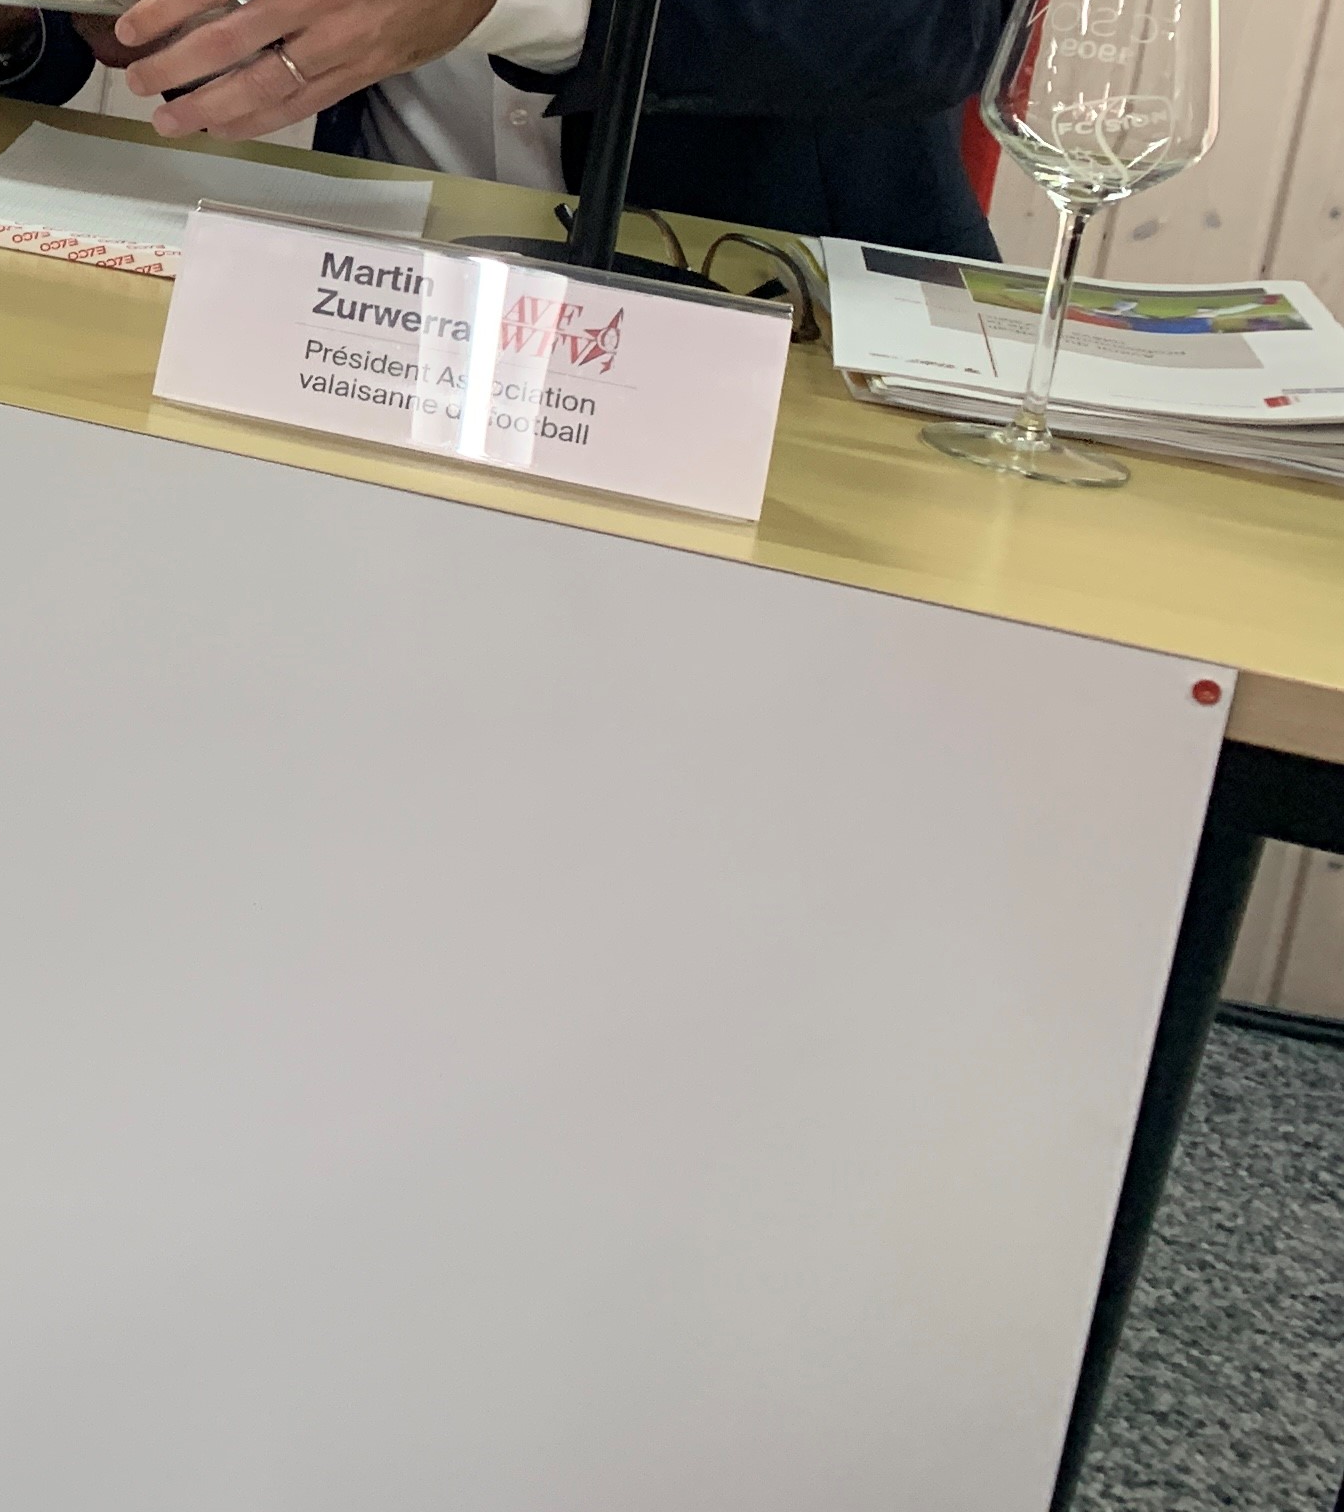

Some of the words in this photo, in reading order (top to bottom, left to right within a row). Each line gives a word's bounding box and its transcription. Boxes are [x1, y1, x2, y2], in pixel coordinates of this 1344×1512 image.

[40, 237, 79, 252] ELCO
[67, 245, 107, 262] ELCO
[320, 251, 436, 298] Martin
[312, 287, 471, 343] Zurwerra
[299, 372, 438, 415] valaisanne
[304, 339, 431, 383] Président
[435, 364, 597, 416] Asociation
